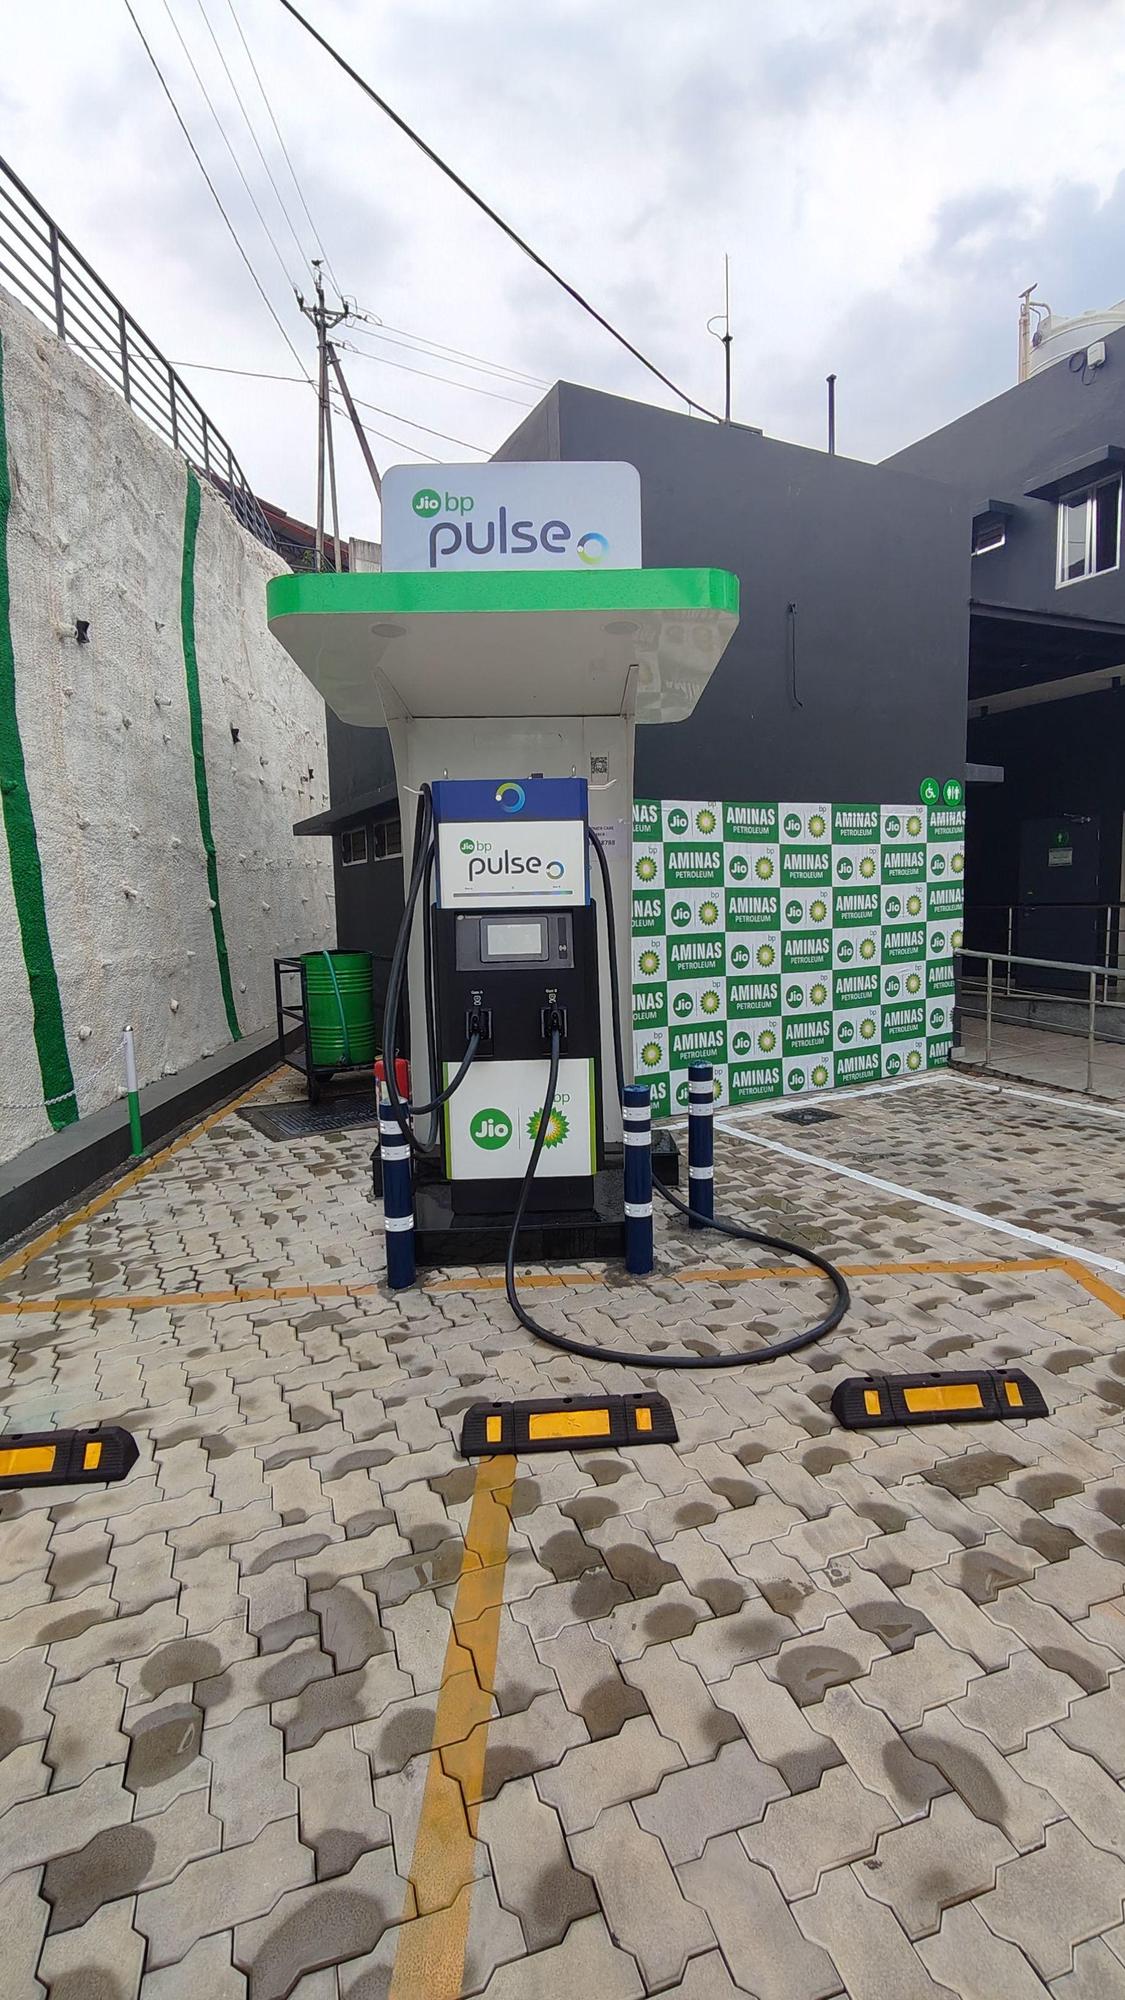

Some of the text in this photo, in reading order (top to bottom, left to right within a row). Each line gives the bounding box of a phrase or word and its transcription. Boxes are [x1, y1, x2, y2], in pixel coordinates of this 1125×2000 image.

[416, 492, 474, 516] Jio bp
[429, 506, 571, 568] pulse
[632, 804, 657, 823] NAS
[727, 807, 775, 825] AMINAS
[670, 815, 687, 828] Jio
[786, 820, 800, 830] Jio
[835, 812, 877, 827] AMINAS
[733, 826, 769, 834] PETROLEUM
[886, 821, 899, 832] Jio
[461, 841, 492, 852] Jio bp
[469, 849, 542, 881] pulse
[669, 852, 720, 869] AMINAS
[784, 854, 829, 870] AMINAS
[884, 852, 924, 868] AMINAS
[932, 860, 944, 870] Jio
[731, 862, 747, 874] Jio
[838, 862, 852, 873] Jio
[889, 868, 919, 876] PETROLEUM
[790, 871, 823, 879] PETROLEUM
[729, 897, 777, 914] AMINAS
[836, 894, 877, 911] AMINAS
[887, 901, 899, 912] Jio
[673, 908, 690, 920] Jio
[787, 907, 801, 917] Jio
[885, 930, 924, 948] AMINAS
[932, 937, 944, 948] Jio
[671, 942, 722, 961] AMINAS
[785, 938, 829, 956] AMINAS
[839, 945, 852, 956] Jio
[889, 947, 918, 956] PETROLEUM
[733, 951, 748, 962] Jio
[791, 955, 823, 964] PETROLEUM
[678, 961, 716, 970] PETROLEUM
[929, 965, 954, 982] AMIN
[712, 980, 721, 988] bp
[836, 975, 877, 993] AMINAS
[886, 980, 899, 991] Jio
[730, 983, 778, 1001] AMINAS
[788, 991, 802, 1002] Jio
[841, 992, 872, 1001] PETROLEUM
[632, 992, 663, 1010] INAS
[675, 999, 691, 1011] Jio
[737, 1001, 772, 1010] PETROLEUM
[633, 1012, 657, 1021] OLEUM
[884, 1008, 923, 1027] AMINAS
[931, 1013, 944, 1024] Jio
[769, 1020, 777, 1028] bp
[889, 1024, 918, 1034] PETROLEUM
[786, 1020, 830, 1040] AMINAS
[839, 1027, 853, 1038] Jio
[654, 1032, 663, 1040] bp
[673, 1030, 724, 1051] AMINAS
[735, 1038, 749, 1048] Jio
[792, 1038, 824, 1048] PETROLEUM
[680, 1050, 717, 1060] PETROLEUM
[837, 1053, 879, 1074] AMINAS
[887, 1058, 899, 1069] Jio
[715, 1068, 723, 1076] bp
[733, 1067, 780, 1088] AMINAS
[843, 1071, 874, 1081] PETROLEUM
[789, 1074, 803, 1085] Jio
[678, 1087, 688, 1100] Ji
[739, 1086, 774, 1095] PETROLEUM
[475, 1119, 509, 1138] Jio
